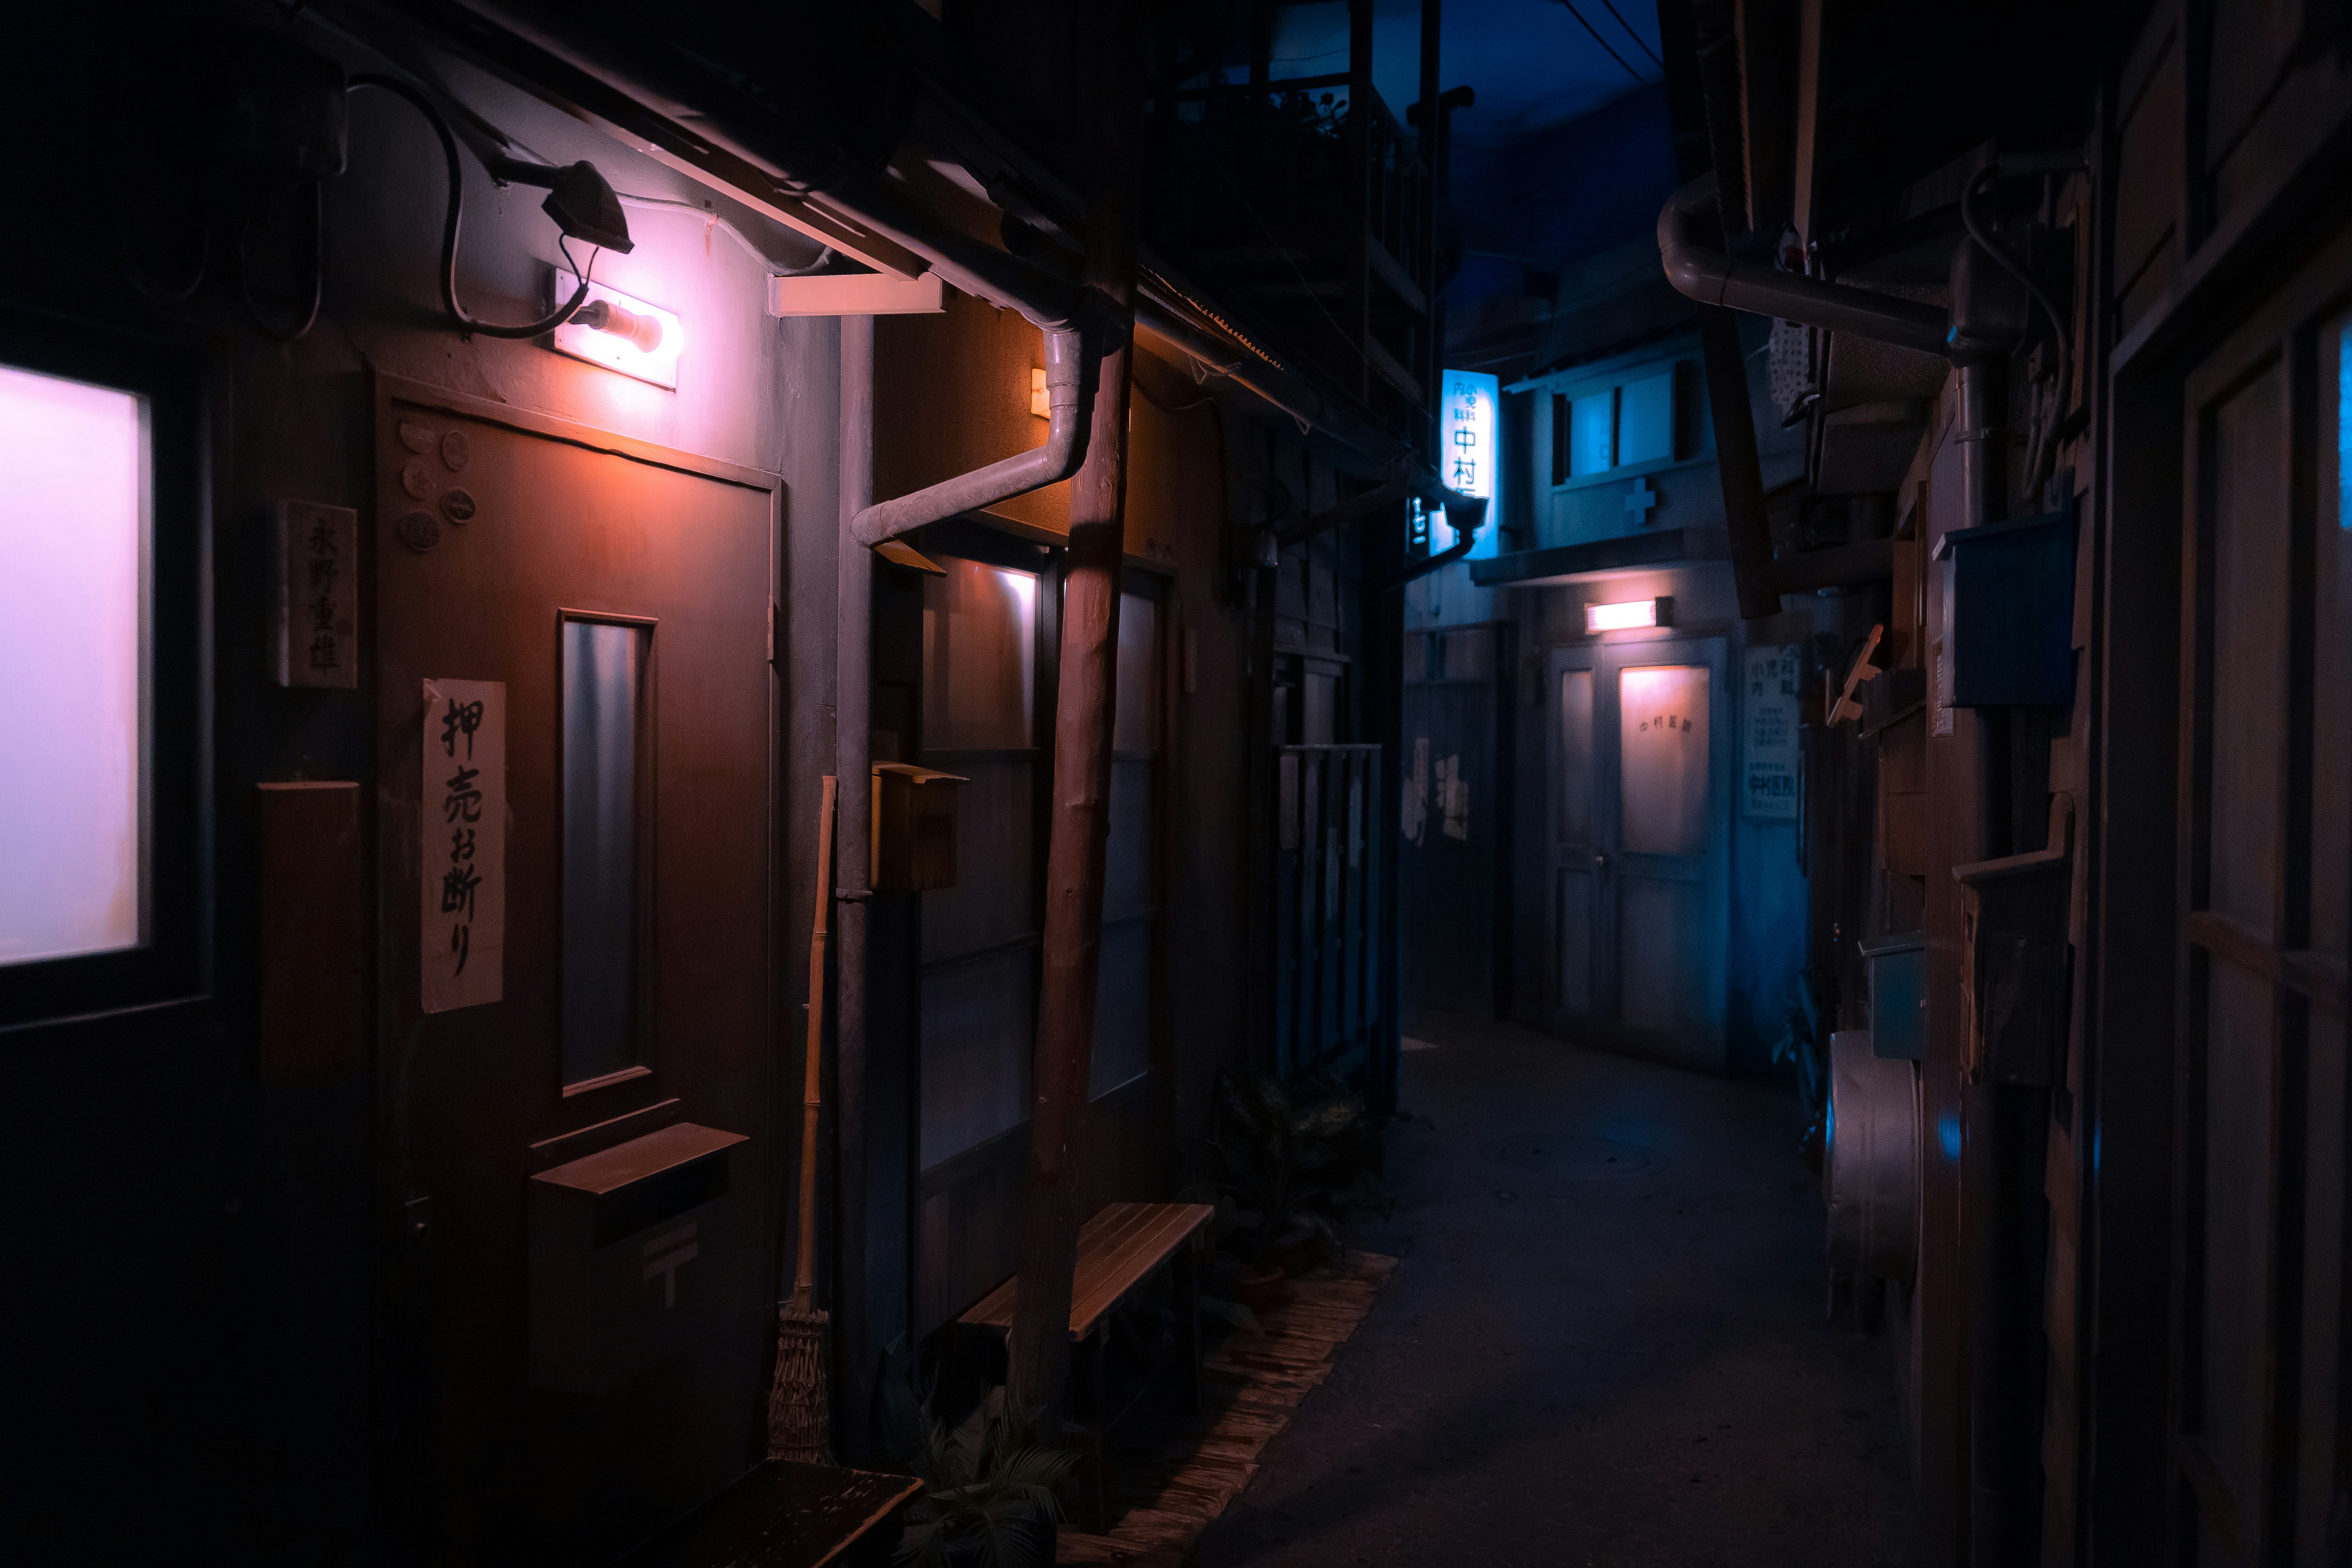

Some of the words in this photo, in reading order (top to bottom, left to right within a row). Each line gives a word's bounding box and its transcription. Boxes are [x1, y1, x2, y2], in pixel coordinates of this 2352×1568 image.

[1454, 426, 1477, 492] 中村
[308, 517, 339, 670] 永野重雄
[441, 697, 484, 978] 押売お断り
